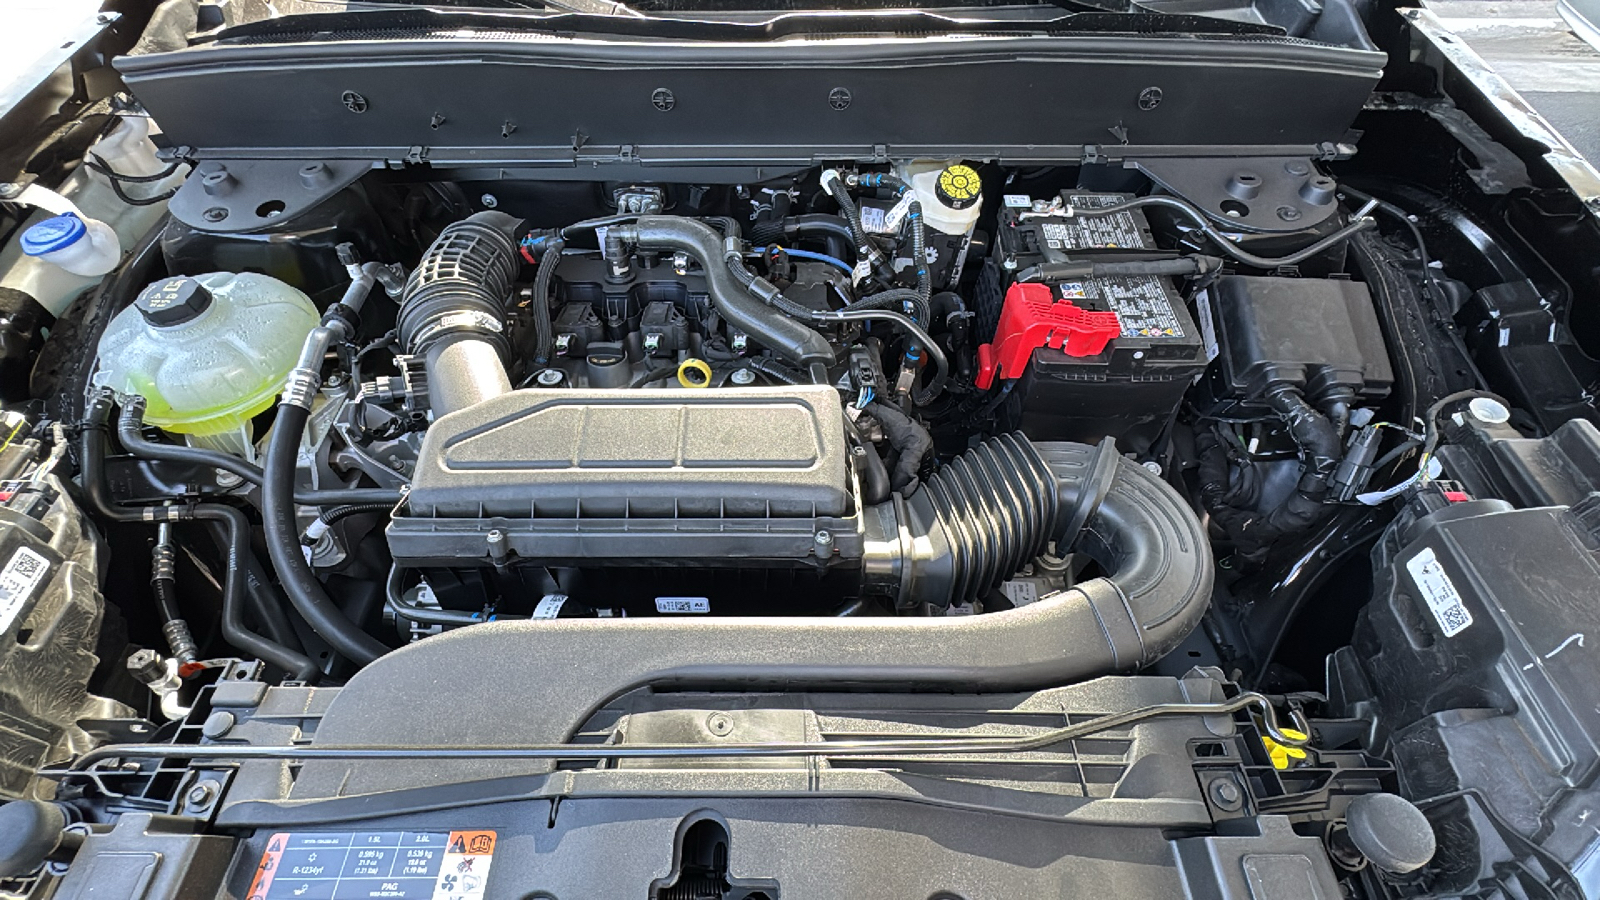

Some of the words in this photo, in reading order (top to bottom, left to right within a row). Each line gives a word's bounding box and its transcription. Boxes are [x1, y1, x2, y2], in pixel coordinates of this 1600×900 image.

[415, 835, 430, 843] 2.0L
[375, 850, 384, 860] kg
[424, 850, 433, 859] kg
[292, 865, 324, 876] R-1234yf
[381, 882, 399, 891] PAG
